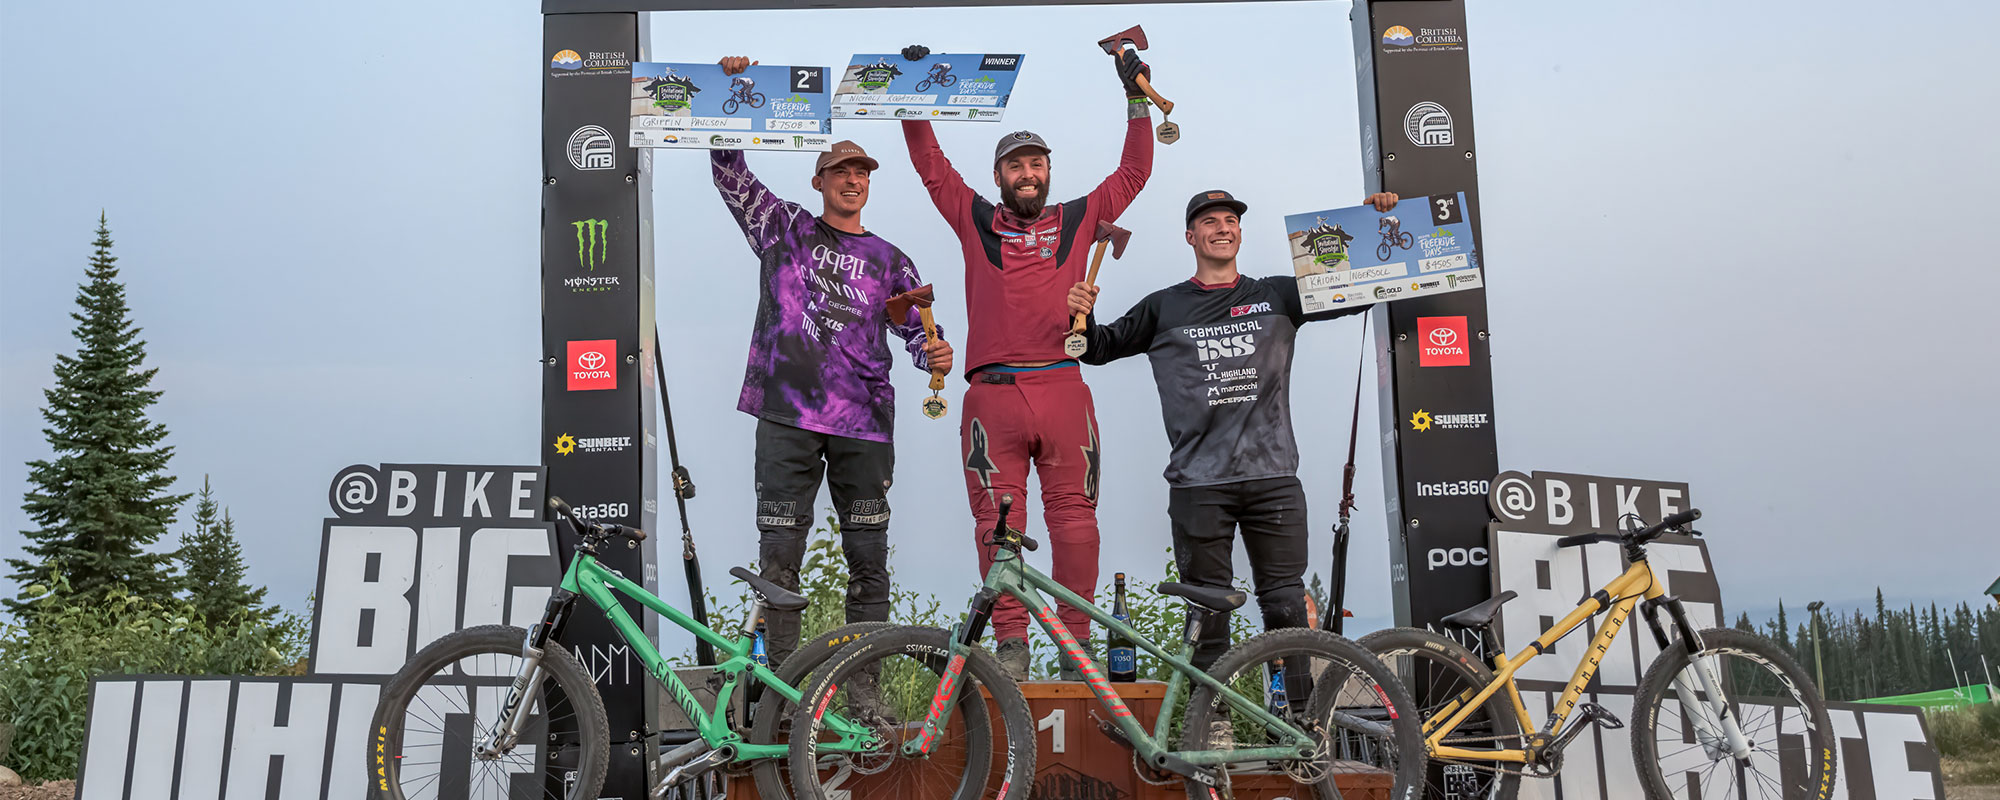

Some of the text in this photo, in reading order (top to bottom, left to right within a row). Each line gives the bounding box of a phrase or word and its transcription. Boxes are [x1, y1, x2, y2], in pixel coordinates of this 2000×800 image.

[1420, 28, 1457, 36] BRITISH
[1416, 36, 1462, 44] COLUMBIA
[590, 52, 624, 60] BRITISH
[584, 59, 630, 67] COLUMBIA
[797, 70, 818, 88] 2nd
[959, 82, 996, 90] FREERIDE
[770, 102, 811, 112] FREERIDE
[773, 110, 794, 118] DAYS
[1436, 198, 1453, 220] 3rd
[1418, 236, 1456, 249] FREERIDE
[1424, 247, 1442, 257] DAYS
[812, 244, 867, 280] ilabb
[564, 276, 620, 288] MONSTER
[800, 264, 869, 305] CANYON
[828, 300, 862, 316] DEGREE
[1248, 302, 1272, 314] AYR
[802, 312, 821, 341] TITLE
[1425, 347, 1463, 355] TOYOTA
[573, 370, 611, 380] TOYOTA
[1221, 368, 1257, 378] HIGHLAND
[1221, 382, 1258, 393] marzocchi
[1209, 395, 1258, 406] RACEFACE
[336, 470, 537, 518] @BIKE
[1417, 481, 1488, 496] Insta360
[1496, 478, 1683, 532] @BIKE
[1428, 547, 1488, 570] poc
[314, 526, 552, 676] BIG
[906, 644, 933, 653] SWISS
[810, 671, 833, 705] MICHELIN
[656, 661, 702, 728] CANYON
[1038, 708, 1064, 753] 1
[377, 725, 388, 791] MAXXIS
